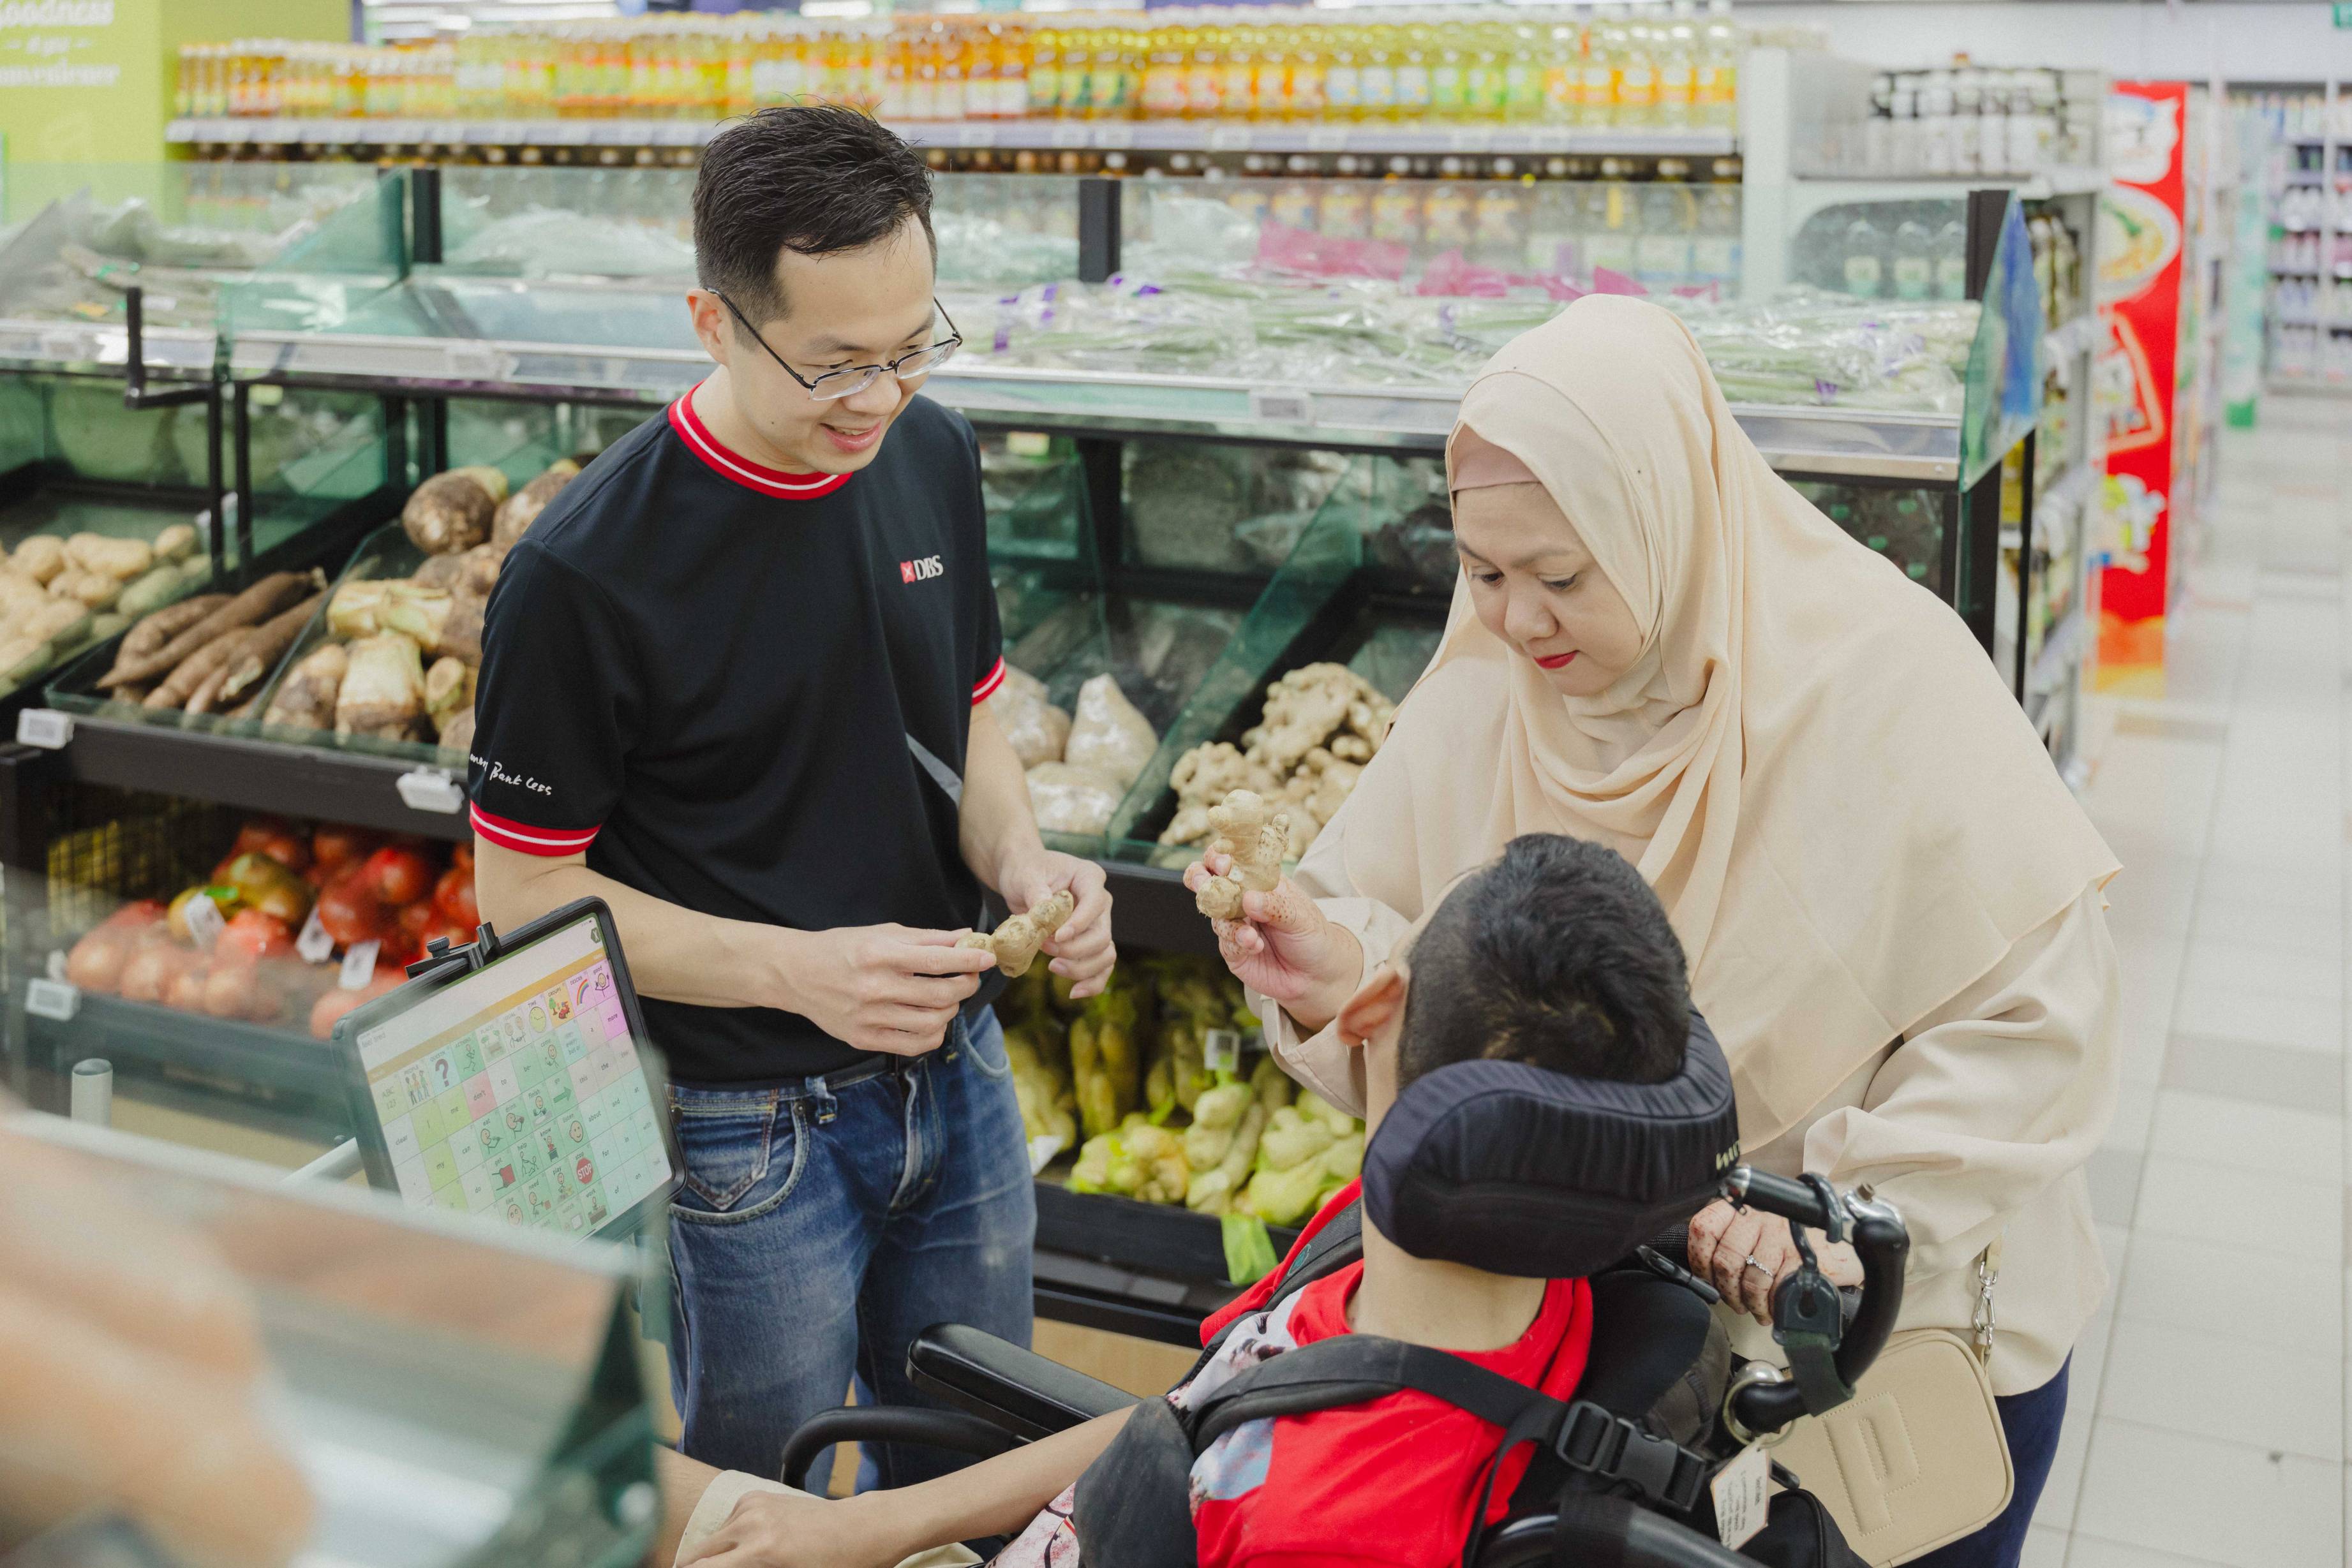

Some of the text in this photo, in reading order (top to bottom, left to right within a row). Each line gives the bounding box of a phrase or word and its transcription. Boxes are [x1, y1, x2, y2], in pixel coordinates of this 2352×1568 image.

[913, 554, 944, 581] DBS
[489, 761, 523, 785] Bank
[593, 965, 602, 975] good
[547, 987, 562, 996] GROUPS
[607, 1013, 618, 1022] more
[579, 1074, 588, 1083] this
[382, 1086, 394, 1097] ABC
[473, 1090, 486, 1101] don't
[528, 1089, 540, 1098] finish
[387, 1098, 396, 1109] 123
[612, 1098, 620, 1107] and
[505, 1104, 517, 1113] drink
[562, 1113, 574, 1123] listen
[588, 1111, 602, 1122] about
[540, 1127, 551, 1137] know
[396, 1135, 408, 1145] clear
[517, 1142, 527, 1151] help
[575, 1151, 584, 1161] stop
[495, 1157, 503, 1166] get
[553, 1167, 562, 1176] play
[577, 1162, 593, 1180] STOP
[475, 1185, 481, 1194] do
[528, 1179, 539, 1190] need
[614, 1185, 620, 1194] of
[586, 1188, 597, 1198] work
[505, 1197, 514, 1205] like
